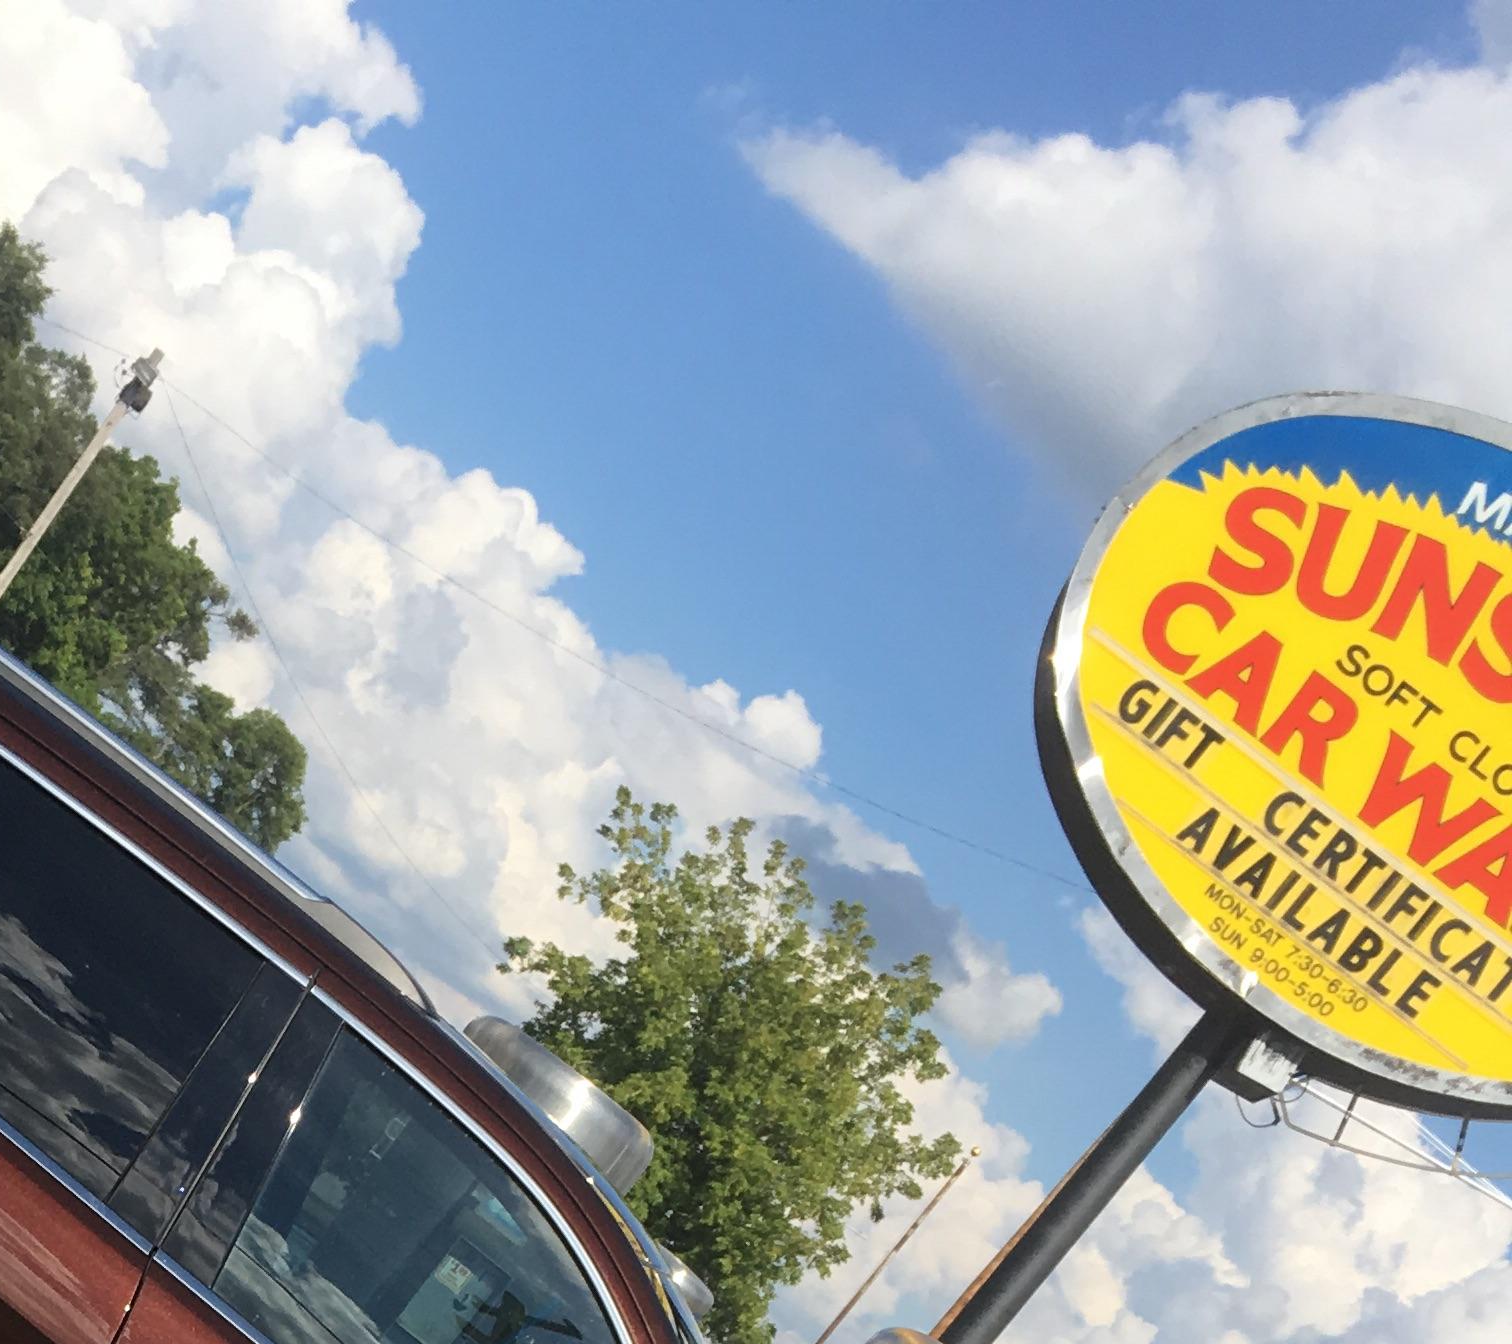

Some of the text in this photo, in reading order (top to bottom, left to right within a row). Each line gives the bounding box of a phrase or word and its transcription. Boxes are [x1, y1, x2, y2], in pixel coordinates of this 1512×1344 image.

[1456, 481, 1512, 536] M
[1119, 679, 1226, 770] GIFT
[1143, 581, 1359, 791] CAR
[1336, 644, 1512, 796] SOFT CLO
[1176, 807, 1442, 1019] AVAILABLE
[1204, 883, 1285, 947] MON-SAT
[1209, 916, 1248, 950] SUN
